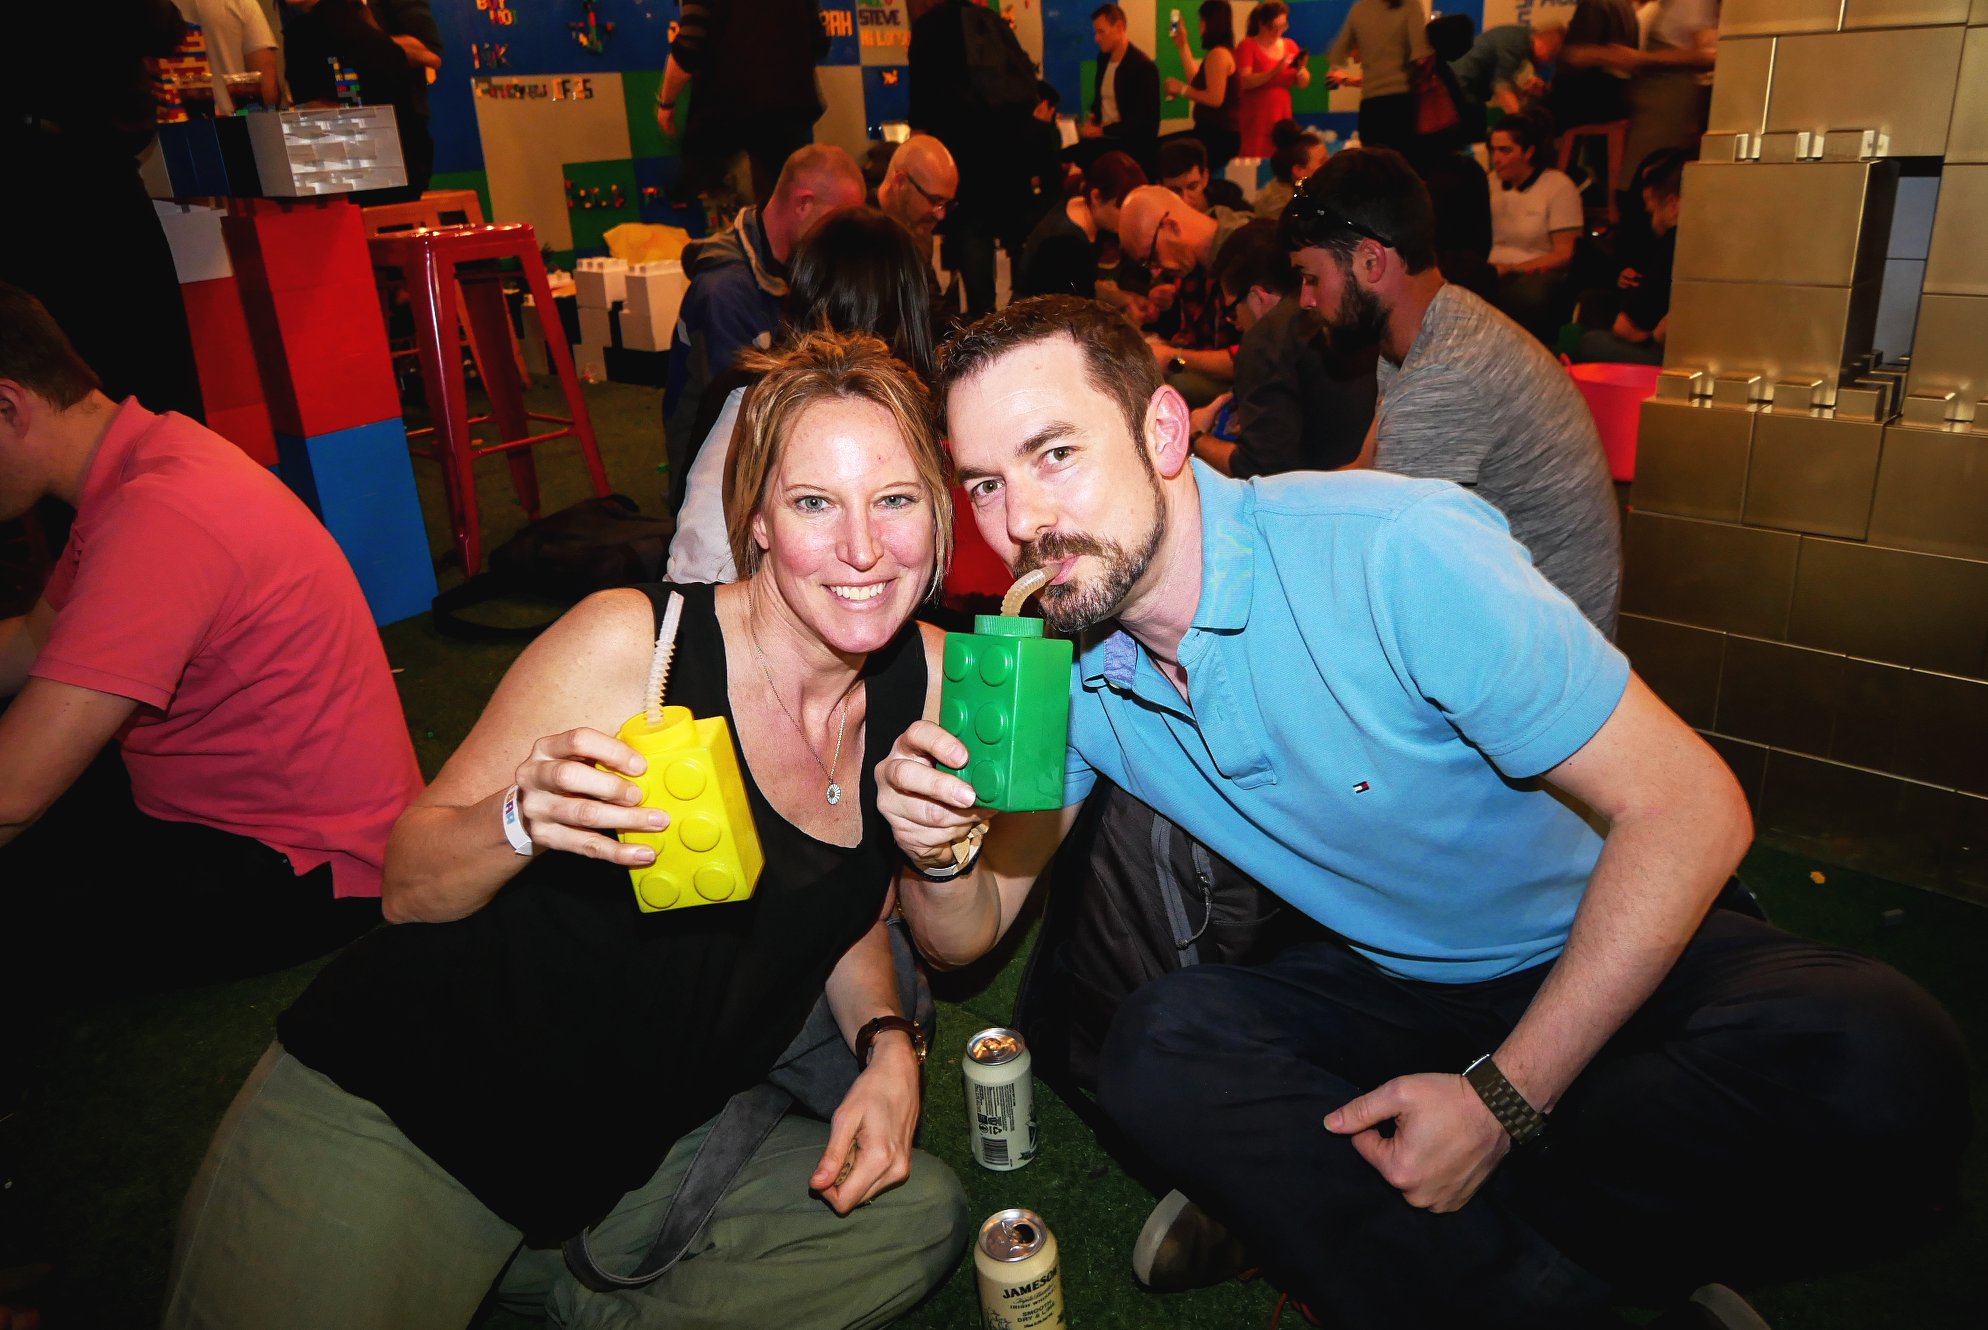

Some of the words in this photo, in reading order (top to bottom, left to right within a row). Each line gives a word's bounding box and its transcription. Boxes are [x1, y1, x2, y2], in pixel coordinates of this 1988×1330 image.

[858, 9, 900, 26] STEVE
[1003, 1266, 1057, 1298] JAMESON
[1022, 1299, 1053, 1317] SMOOTH
[1017, 1315, 1032, 1323] DRY
